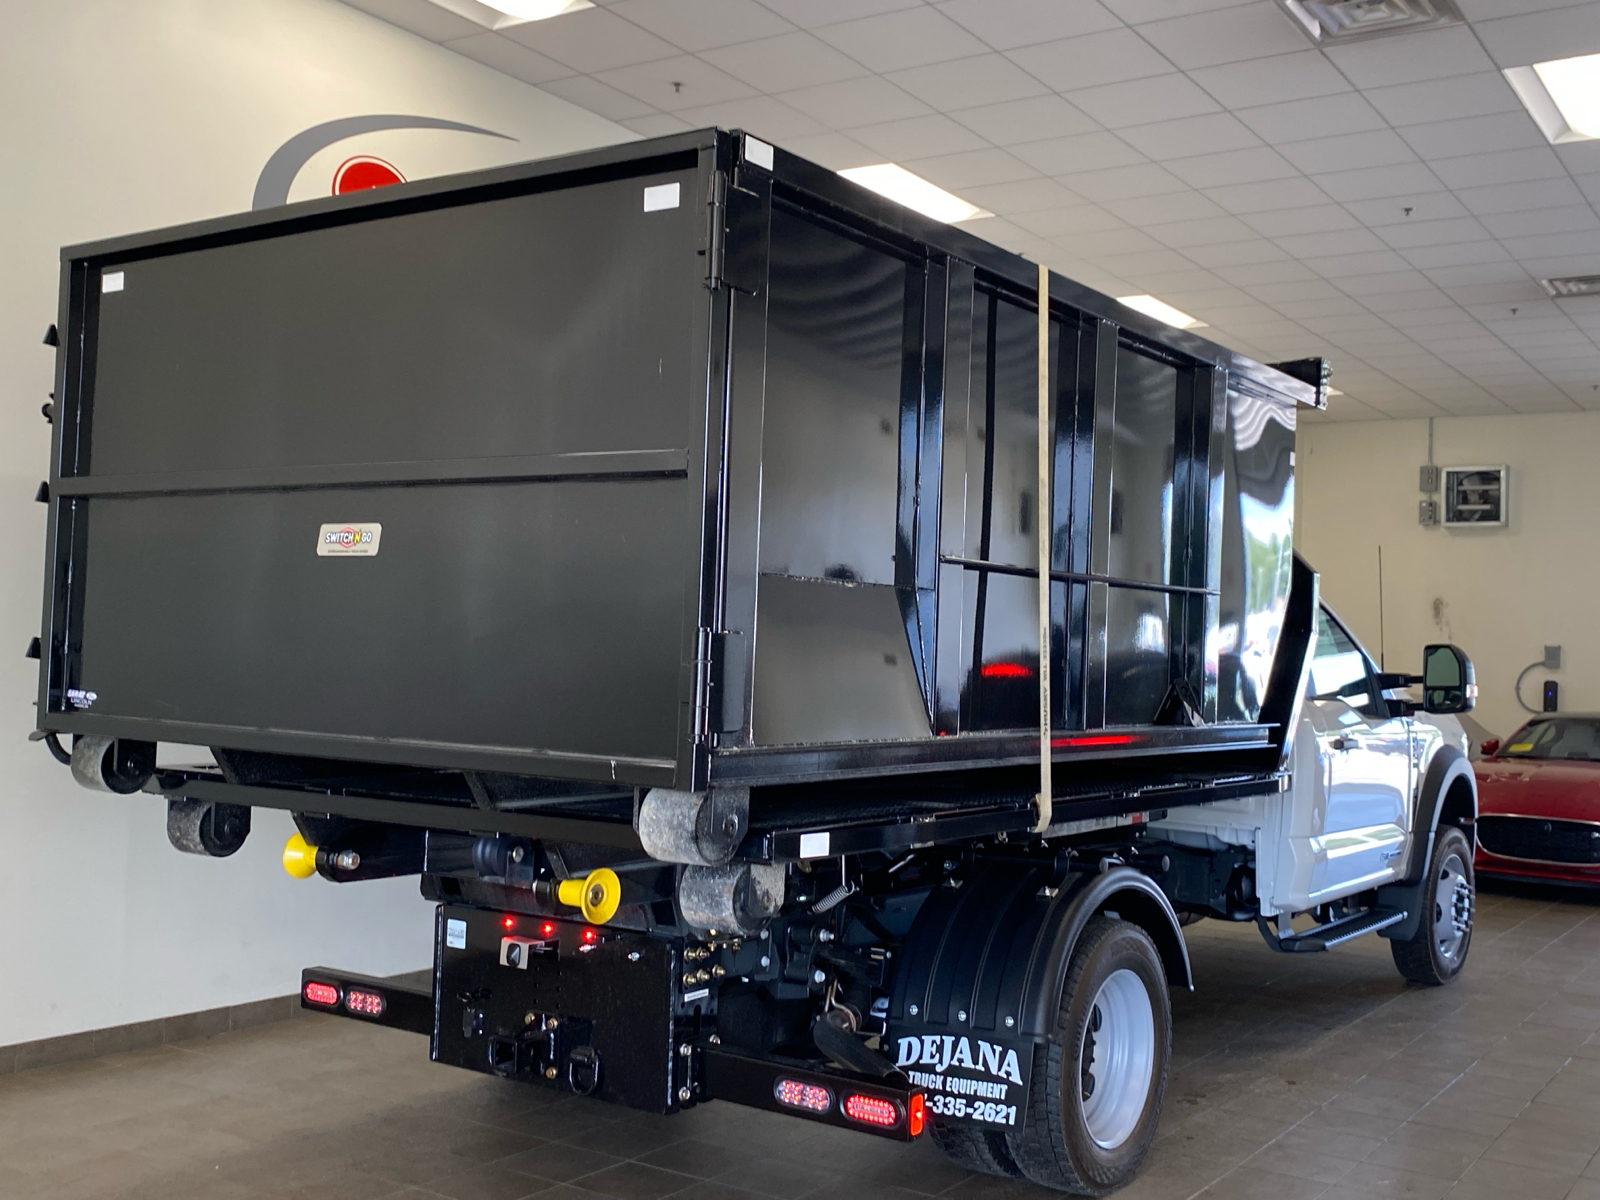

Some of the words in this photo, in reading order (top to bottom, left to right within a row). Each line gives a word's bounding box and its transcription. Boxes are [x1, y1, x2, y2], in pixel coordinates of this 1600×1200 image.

[325, 532, 353, 543] SWITCH
[354, 529, 362, 546] N
[361, 532, 372, 543] GO
[895, 1034, 1023, 1086] DEJANA
[908, 1070, 943, 1090] TRUCK
[946, 1077, 1008, 1100] EQUIPMENT
[924, 1093, 1017, 1126] -335-2621
